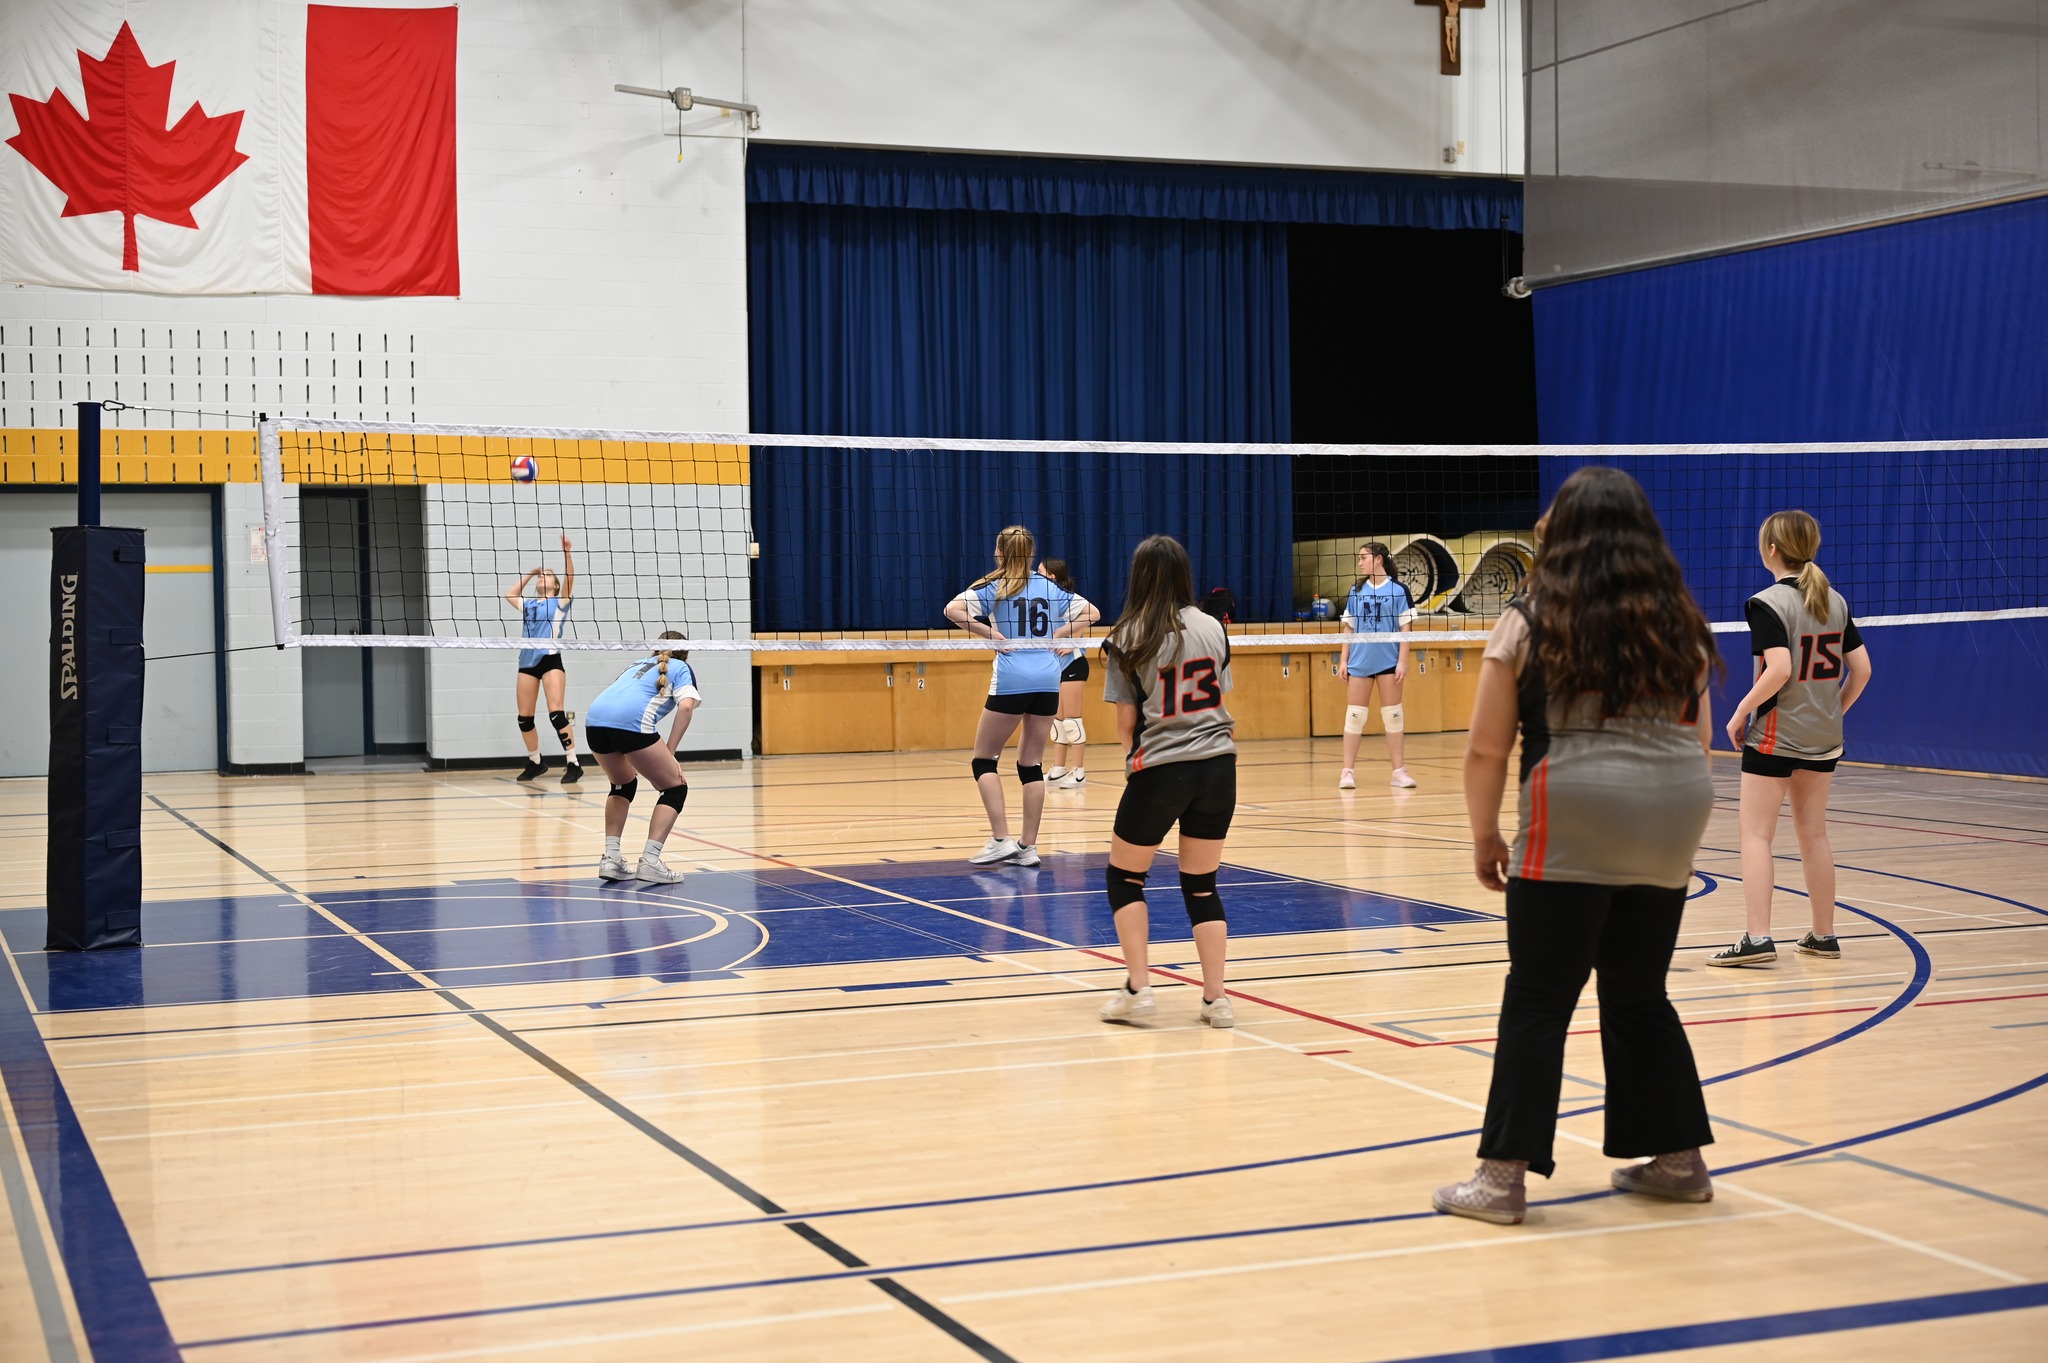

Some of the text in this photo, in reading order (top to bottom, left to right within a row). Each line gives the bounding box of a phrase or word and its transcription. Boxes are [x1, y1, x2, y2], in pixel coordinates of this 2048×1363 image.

[1013, 597, 1048, 637] 16
[60, 574, 78, 700] SPALDING
[1798, 631, 1842, 682] 15
[1283, 667, 1288, 677] 4
[1332, 666, 1337, 675] 6
[1420, 664, 1425, 673] 6
[1457, 662, 1461, 671] 5
[784, 679, 789, 690] 1
[888, 676, 893, 687] 1
[918, 679, 924, 689] 2
[1158, 656, 1222, 718] 13
